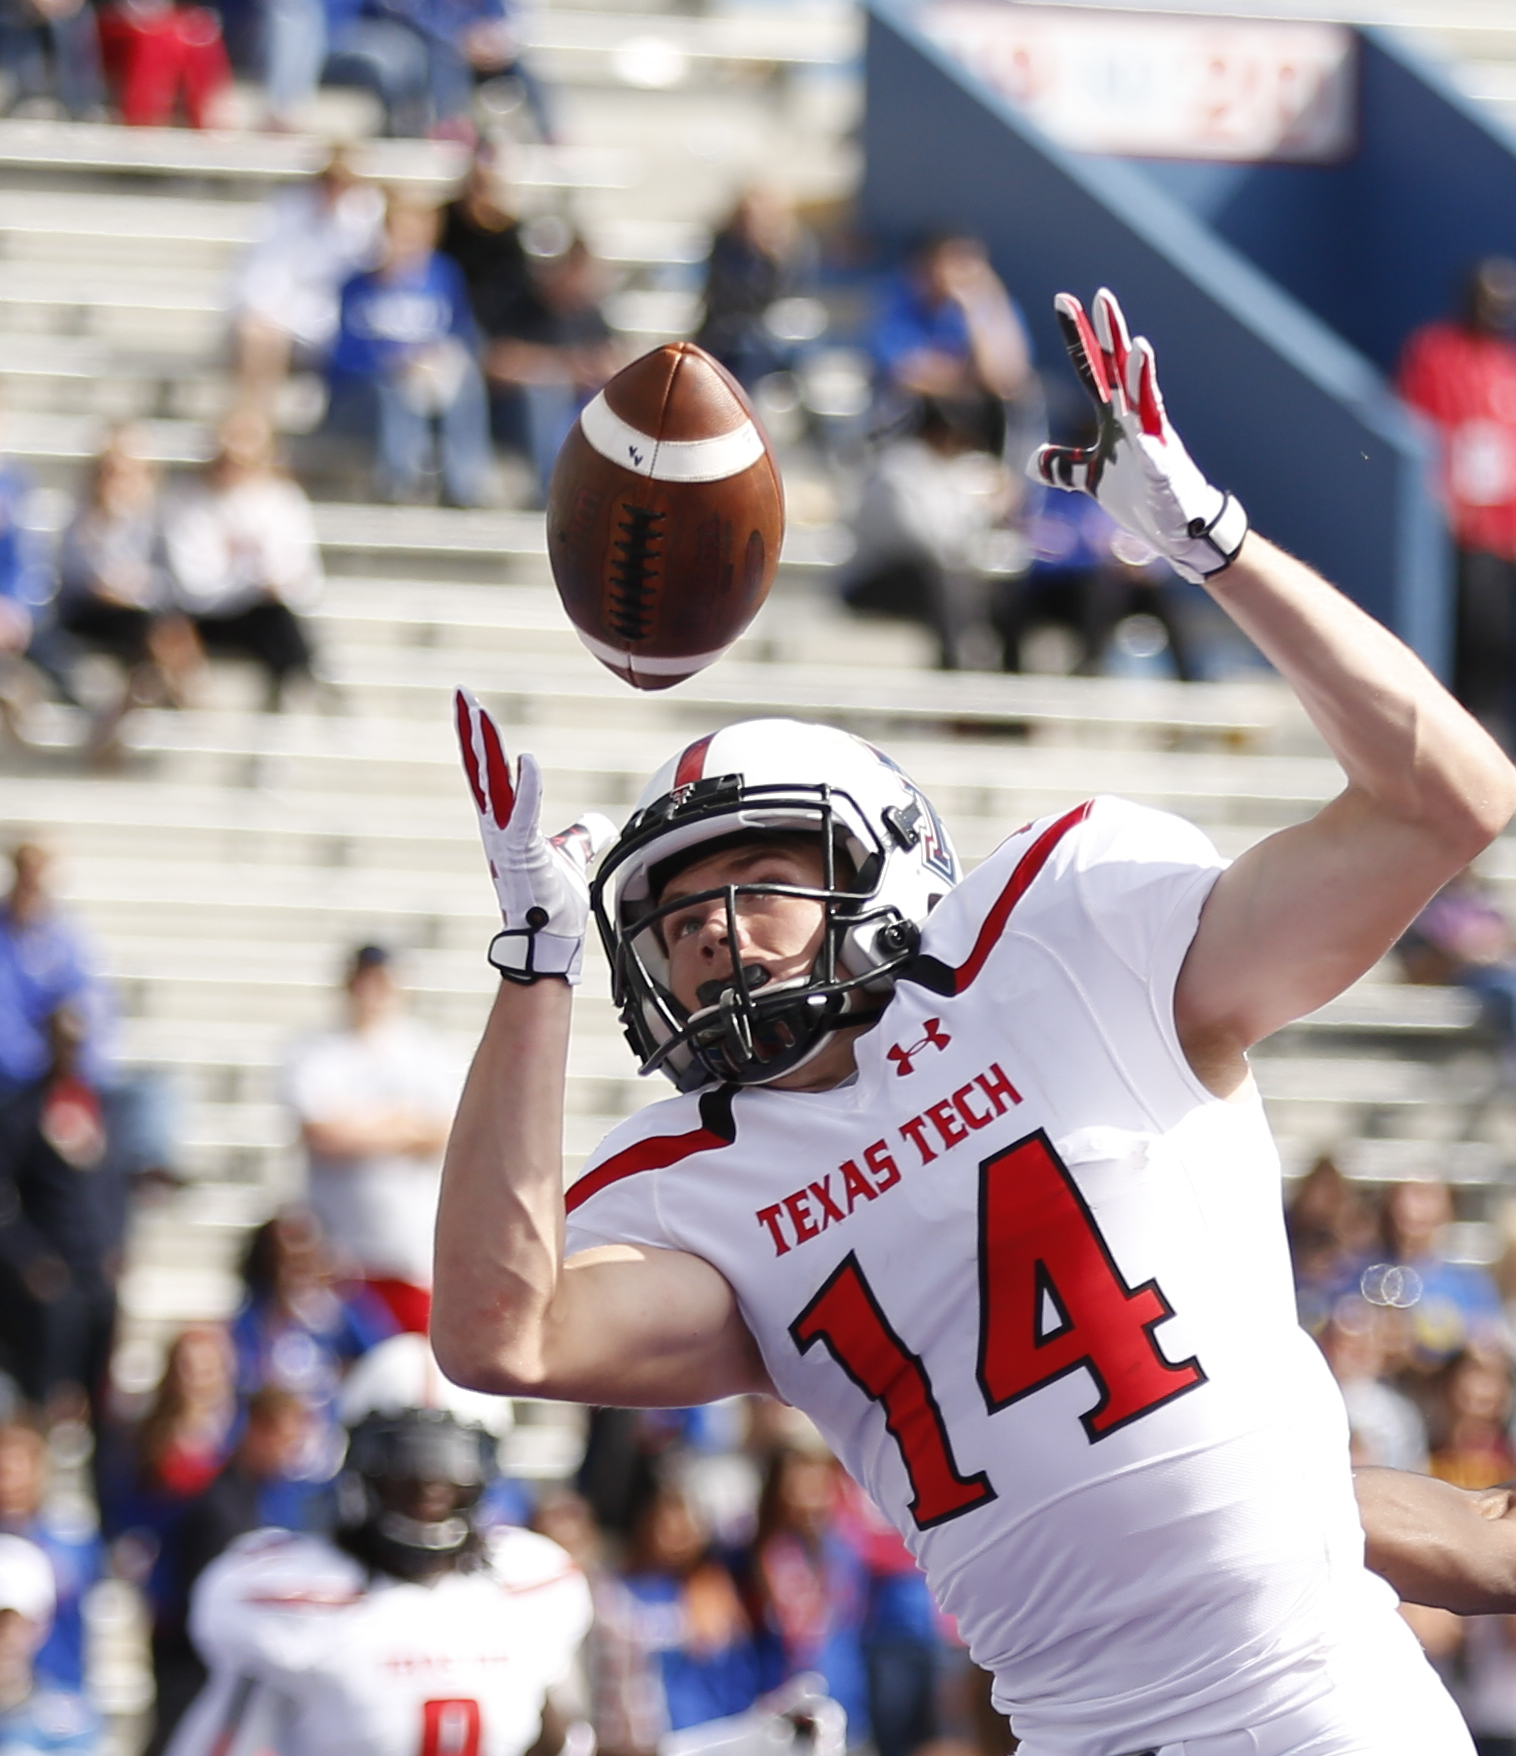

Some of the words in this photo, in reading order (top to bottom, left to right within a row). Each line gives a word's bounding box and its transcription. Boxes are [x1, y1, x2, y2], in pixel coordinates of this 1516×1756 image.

[755, 1137, 902, 1257] TEXAS
[899, 1062, 1024, 1167] TECH
[787, 1126, 1210, 1532] 14
